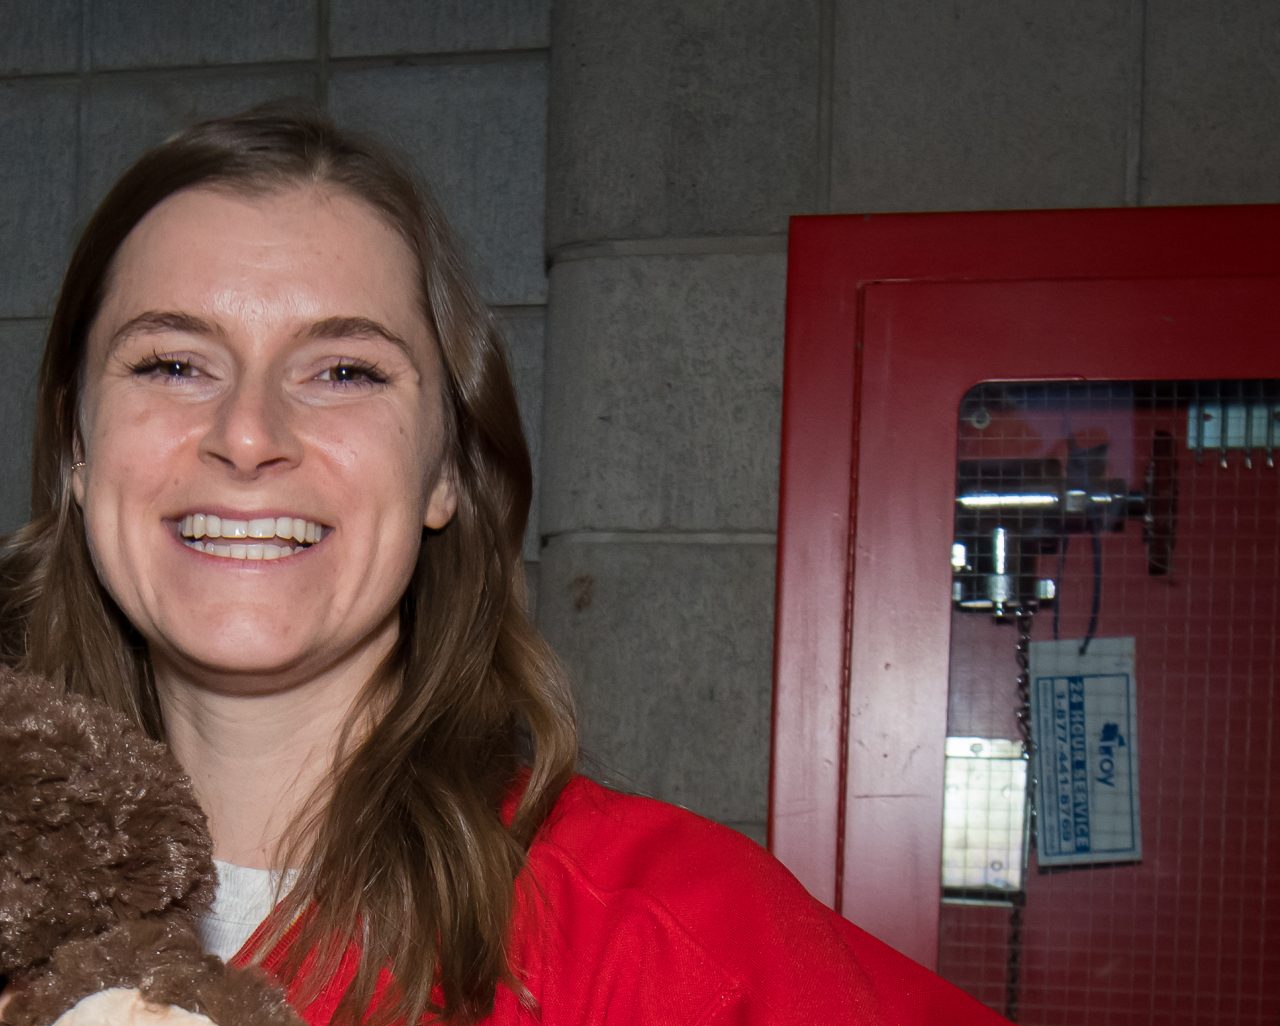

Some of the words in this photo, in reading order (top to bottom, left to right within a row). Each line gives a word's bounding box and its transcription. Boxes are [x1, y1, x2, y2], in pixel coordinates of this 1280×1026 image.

[1069, 681, 1084, 703] 24
[1071, 709, 1086, 761] HOUR
[1073, 769, 1090, 848] SERVICE
